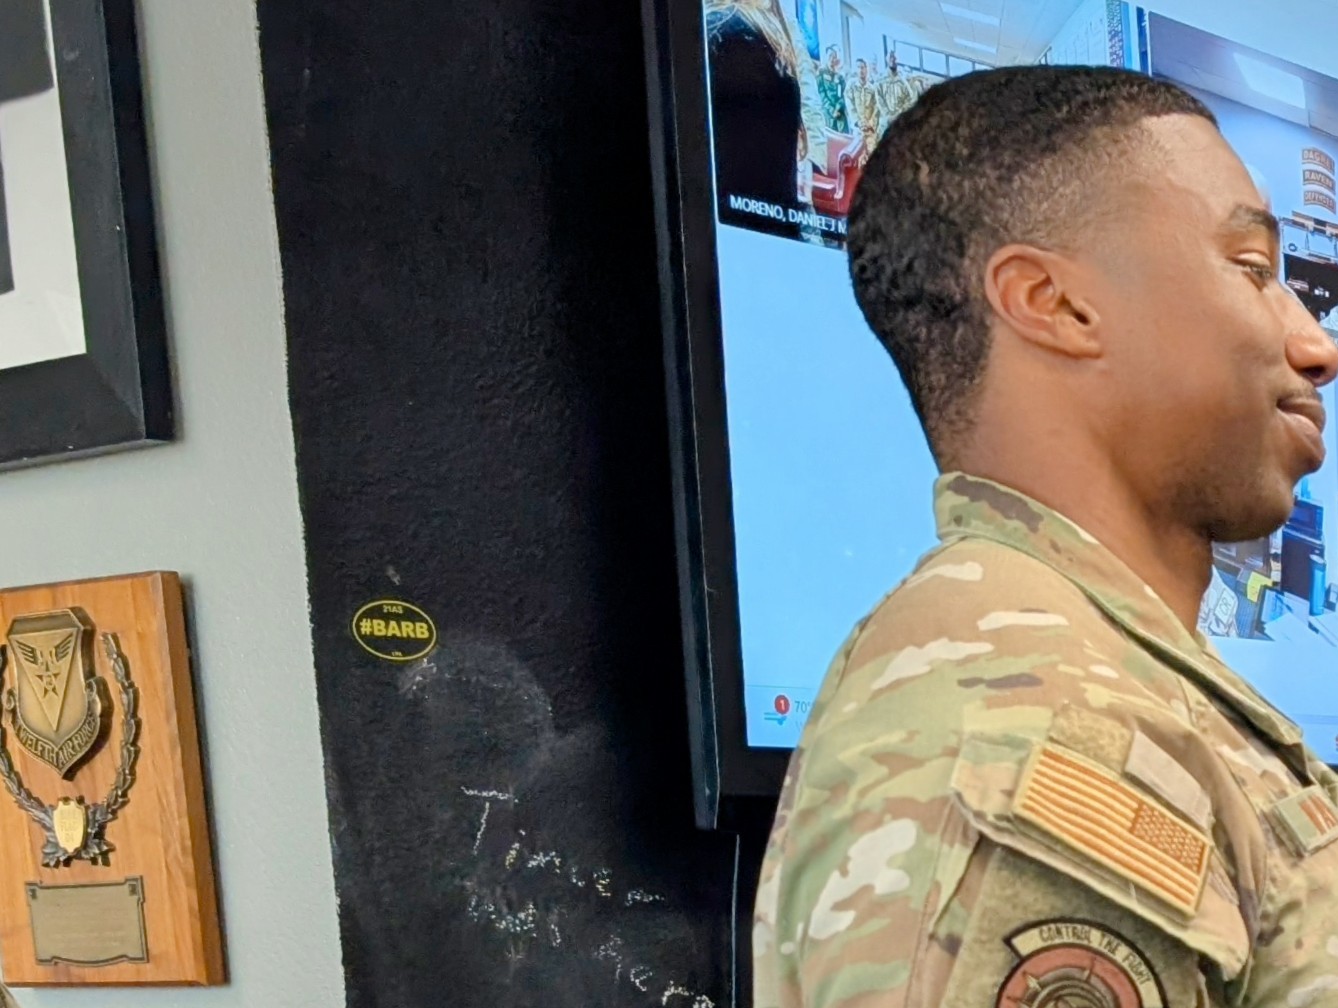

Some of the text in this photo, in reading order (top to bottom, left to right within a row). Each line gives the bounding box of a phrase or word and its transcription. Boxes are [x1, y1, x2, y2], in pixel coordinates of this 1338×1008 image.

[729, 194, 787, 222] MORENO,
[788, 208, 829, 231] DANIEL
[359, 617, 430, 639] #BARB
[58, 741, 76, 768] AIR
[1039, 923, 1152, 985] CONTROL THE FIGHT
